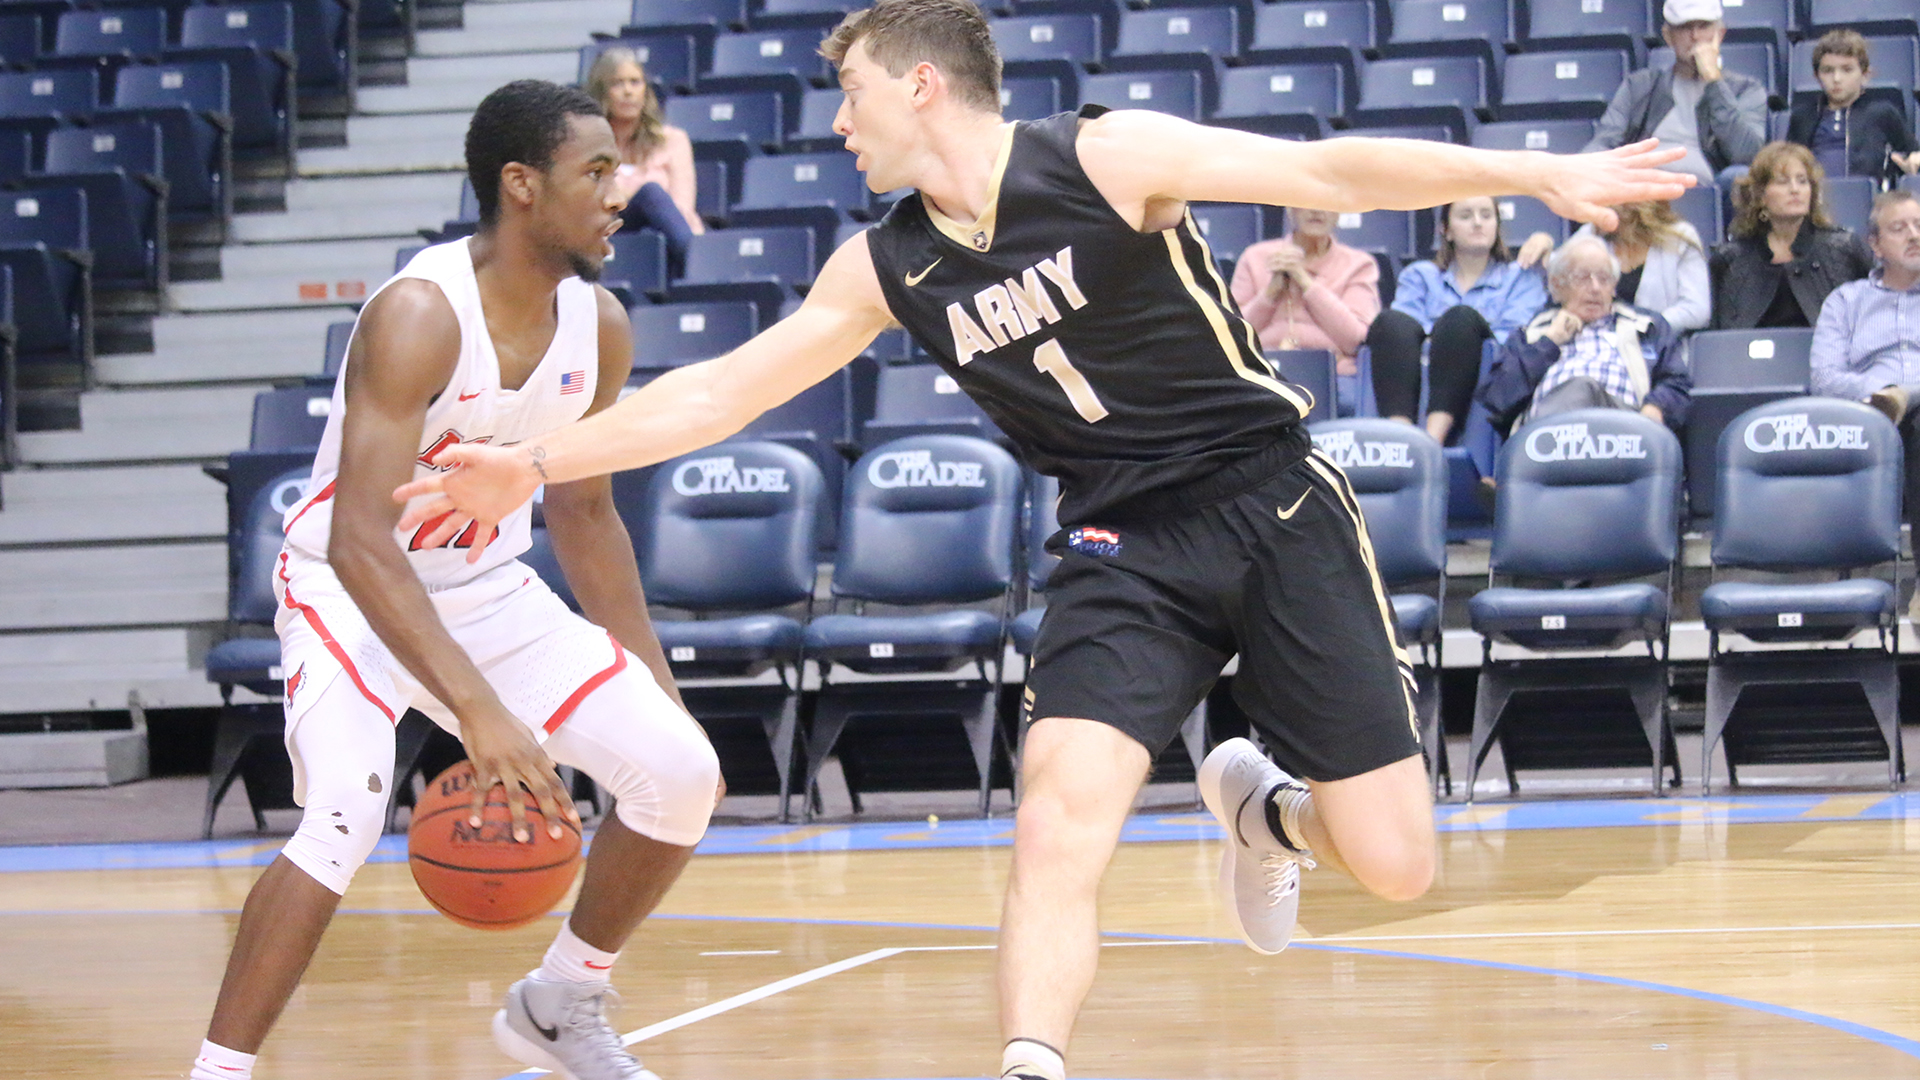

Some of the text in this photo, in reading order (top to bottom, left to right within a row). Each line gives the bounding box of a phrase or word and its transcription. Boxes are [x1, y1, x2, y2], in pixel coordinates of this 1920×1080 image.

[946, 245, 1089, 367] ARMY
[1033, 337, 1110, 424] 1
[1554, 423, 1588, 442] THE
[1774, 413, 1808, 432] THE
